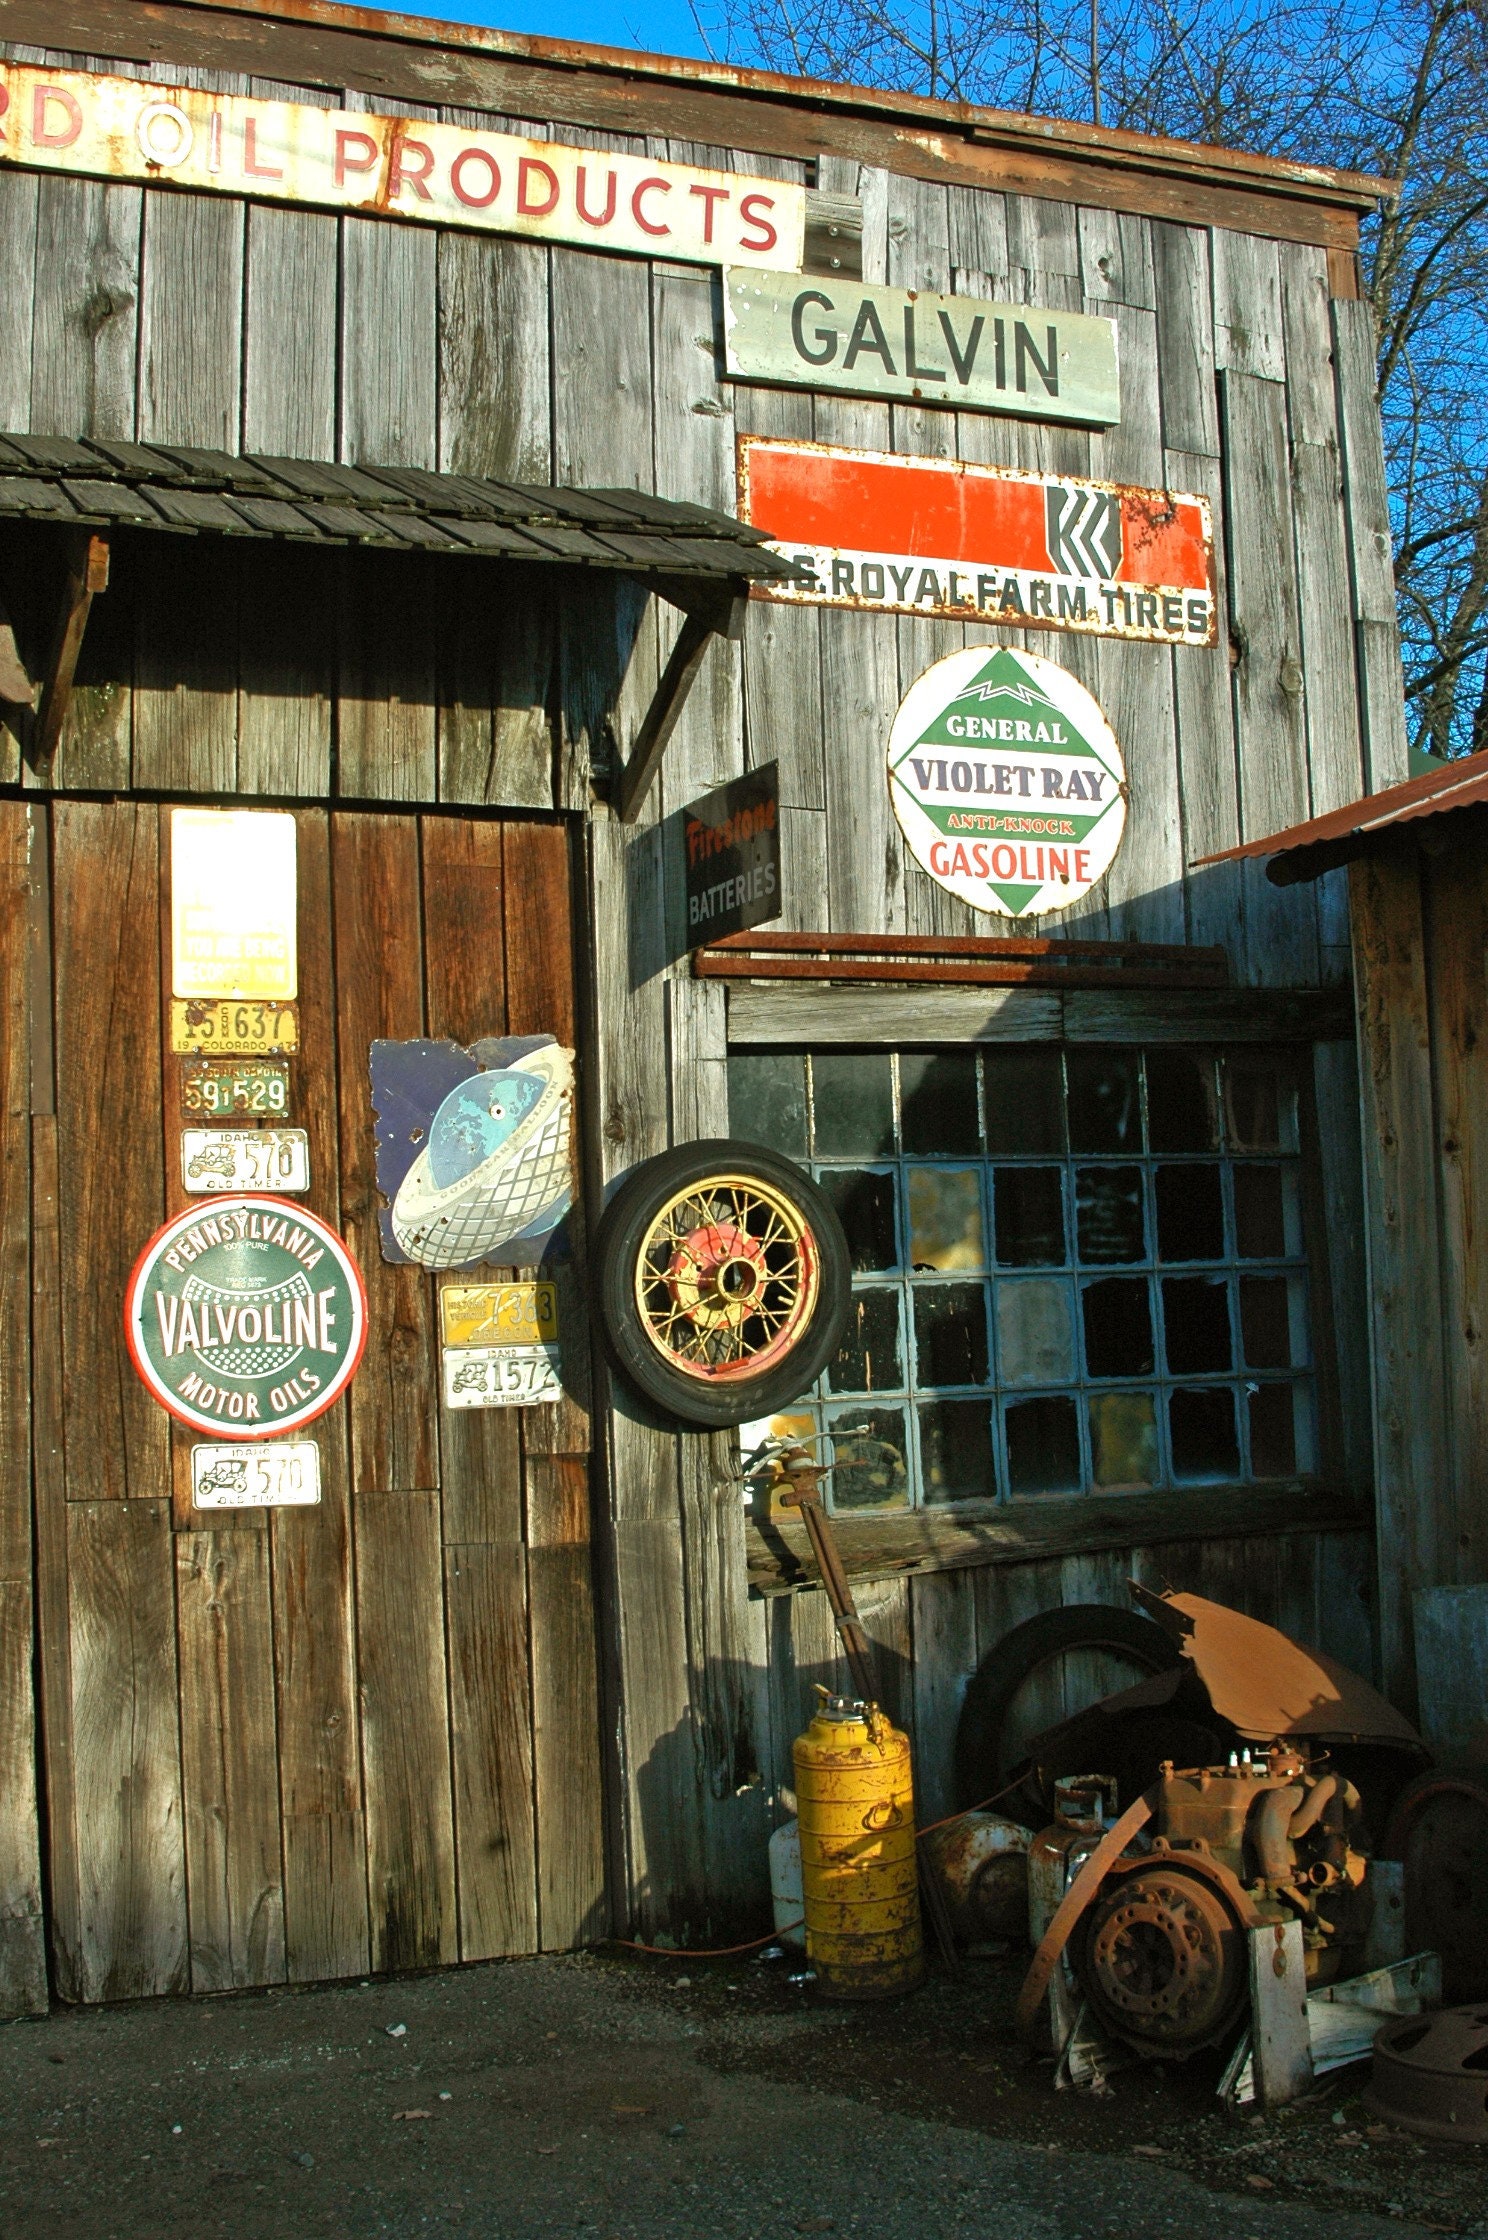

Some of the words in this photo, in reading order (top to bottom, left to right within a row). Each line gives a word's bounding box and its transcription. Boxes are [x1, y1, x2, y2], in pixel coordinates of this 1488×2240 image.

[0, 82, 83, 149] D
[135, 100, 284, 179] OIL
[332, 128, 778, 252] PRODUCTS
[791, 290, 1060, 397] GALVIN
[832, 559, 967, 608] ROYAL
[977, 573, 1089, 622] FARM
[1100, 589, 1208, 634] TIRES
[946, 715, 1068, 745] GENERAL
[908, 757, 1036, 797] VIOLET
[1040, 767, 1107, 802] RAY
[686, 800, 776, 870] Firestone
[947, 812, 1076, 836] ANTI-KNOCK
[930, 841, 1093, 883] GASOLINE
[689, 862, 776, 926] BATTERIES
[245, 938, 285, 959] BEING
[235, 1006, 282, 1040] 637
[177, 1041, 190, 1050] 19
[203, 1041, 267, 1050] COLORADO
[220, 1133, 260, 1143] IDAHO
[208, 1180, 233, 1189] OLD
[165, 1211, 326, 1273] PENNSYLVANIA
[246, 1241, 270, 1252] PURE
[155, 1286, 337, 1357] VALVOLINE
[488, 1291, 552, 1325] 7363
[487, 1349, 517, 1359] IDAHO
[177, 1371, 261, 1419] MOTOR
[270, 1367, 322, 1413] OILS
[492, 1360, 555, 1392] 1572
